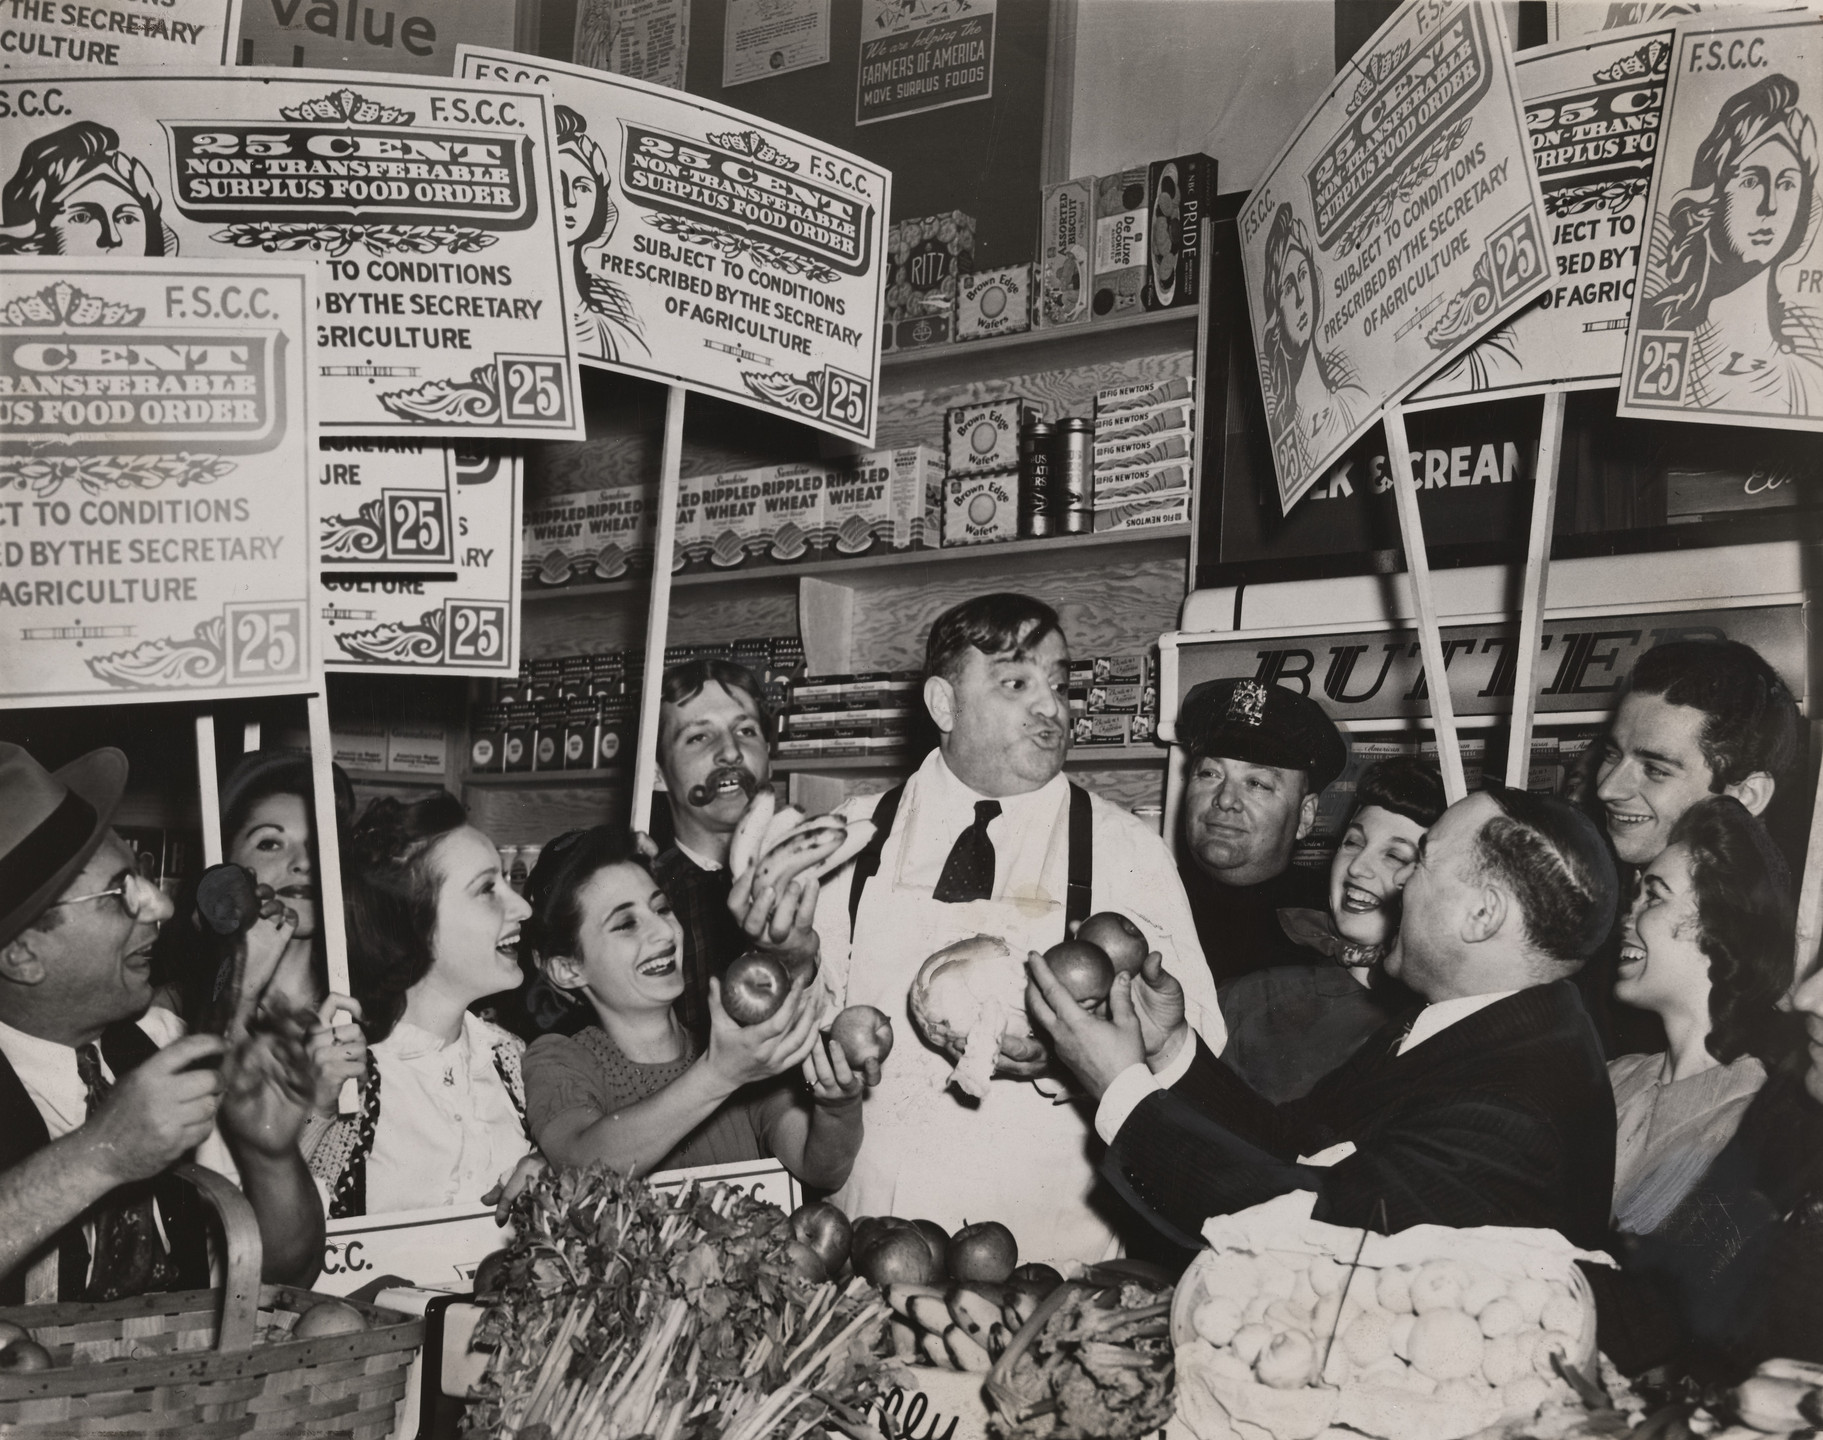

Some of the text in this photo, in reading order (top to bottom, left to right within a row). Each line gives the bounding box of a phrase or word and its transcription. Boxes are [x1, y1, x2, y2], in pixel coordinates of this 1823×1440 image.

[60, 4, 206, 45] SECRETARY
[866, 41, 886, 60] We
[912, 28, 957, 50] helping
[961, 20, 982, 37] the
[862, 40, 985, 87] FARMERS OF AMERICA
[1689, 37, 1768, 72] F.S.C.C.
[864, 66, 985, 106] MOVE SURPLUS FOODS
[431, 97, 525, 128] F.S.C.C.
[1315, 20, 1464, 188] 25 CENT
[1526, 97, 1599, 131] 25
[1315, 40, 1473, 212] NON-TRANSFERABLE
[192, 133, 502, 165] 25 CENT
[1318, 60, 1478, 230] SURPLUS FOOD ORDER
[186, 158, 510, 184] NON-TRANSFERABLE
[639, 136, 853, 219] 25 CENT
[809, 154, 872, 198] F.S.C.C.
[189, 178, 514, 206] SURPLUS FOOD ORDER
[632, 152, 856, 238] NON-TRANSFERABLE
[632, 170, 855, 256] SURPLUS FOOD ORDER
[1057, 193, 1068, 257] ASSORTED
[1068, 198, 1077, 245] BISCUIT
[1182, 200, 1198, 259] PRIDE
[1334, 141, 1487, 299] SUBJECT TO CONDITIONS
[1607, 214, 1636, 237] TO
[1114, 221, 1123, 264] COOKIES
[1122, 216, 1135, 265] De Luxe
[1324, 156, 1510, 344] PRESCRIBED BY THE SECRETARY
[1497, 220, 1537, 293] 25
[327, 260, 512, 286] TO CONDITIONS
[633, 234, 716, 272] SUBJECT
[721, 259, 744, 280] TO
[748, 267, 846, 316] CONDITIONS
[911, 252, 945, 285] RITZ
[1599, 248, 1624, 271] BY
[965, 274, 1019, 301] Brown Edge
[1363, 228, 1471, 337] OF AGRICULTURE
[165, 286, 279, 320] F.S.C.C.
[326, 292, 542, 320] BY THE SECRETARY
[601, 252, 863, 348] PRESCRIBED BY THE SECRETARY
[665, 296, 812, 356] OF AGRICULTURE
[977, 316, 1009, 330] Wafers
[13, 343, 248, 371] CENT
[1638, 341, 1683, 395] 25
[508, 363, 562, 417] 25
[830, 376, 863, 424] 25
[1107, 383, 1154, 398] FIG NEWTONS
[40, 400, 259, 425] FOOD ORDER
[957, 410, 1009, 437] Brown Edge
[1102, 412, 1149, 427] FIG NEWTONS
[968, 451, 1000, 466] Wafers
[1103, 441, 1151, 456] FIG NEWTONS
[1279, 439, 1300, 484] 25
[702, 484, 761, 505] RIPPLED
[714, 474, 748, 487] Sunshine
[762, 476, 823, 496] RIPPLED
[826, 467, 890, 489] RIPPLED
[829, 485, 884, 505] WHEAT
[953, 481, 1010, 507] Brown Edge
[1103, 471, 1149, 485] FIG NEWTONS
[33, 498, 250, 527] TO CONDITIONS
[586, 499, 643, 519] RIPPLED
[705, 502, 756, 520] WHEAT
[764, 493, 818, 513] WHEAT
[1126, 513, 1174, 527] FIG NEWTONS
[394, 499, 441, 550] 25
[589, 516, 639, 534] WHEAT
[965, 523, 999, 537] Wafers
[31, 536, 284, 566] BY THE SECRETARY
[237, 612, 296, 673] 25
[454, 608, 500, 656] 25
[1256, 626, 1729, 704] BUTTE
